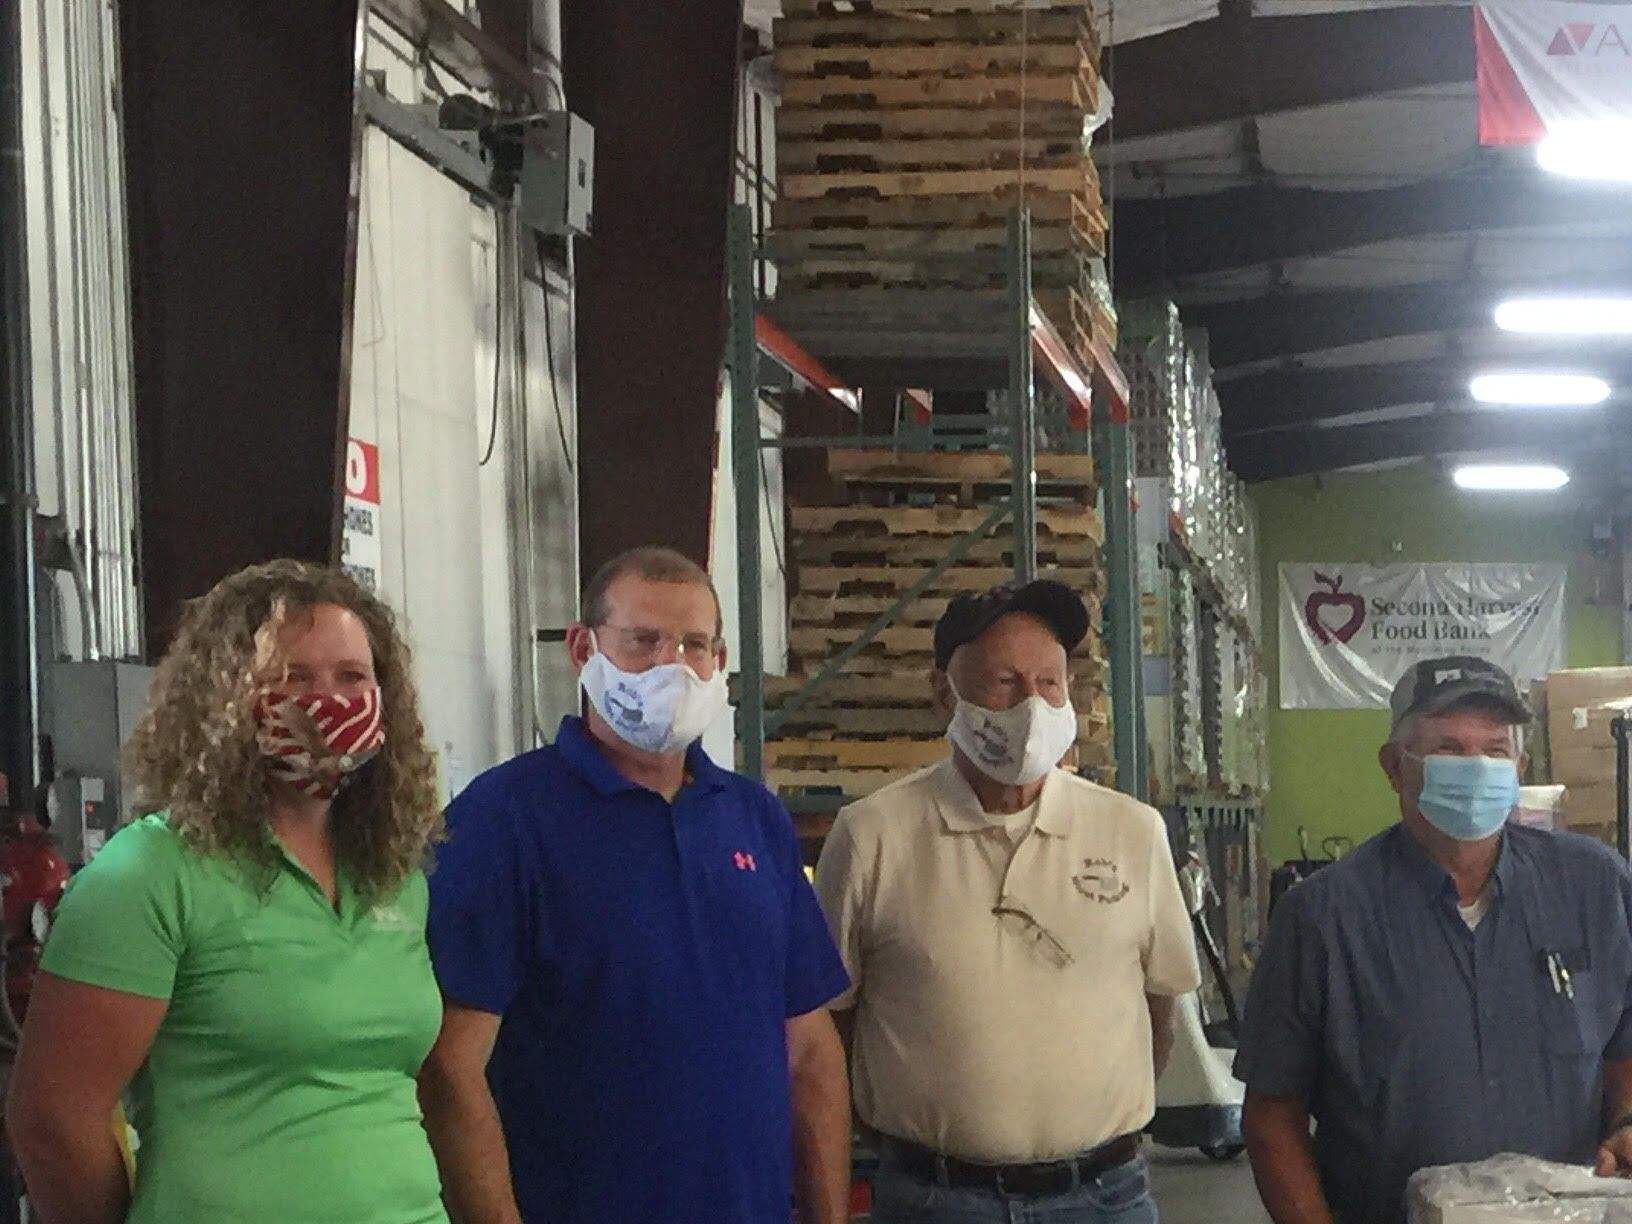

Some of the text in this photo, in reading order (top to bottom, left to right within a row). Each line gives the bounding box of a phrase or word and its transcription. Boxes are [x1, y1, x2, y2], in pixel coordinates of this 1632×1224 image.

[1371, 599, 1451, 616] Second
[1371, 621, 1491, 640] Food Bank
